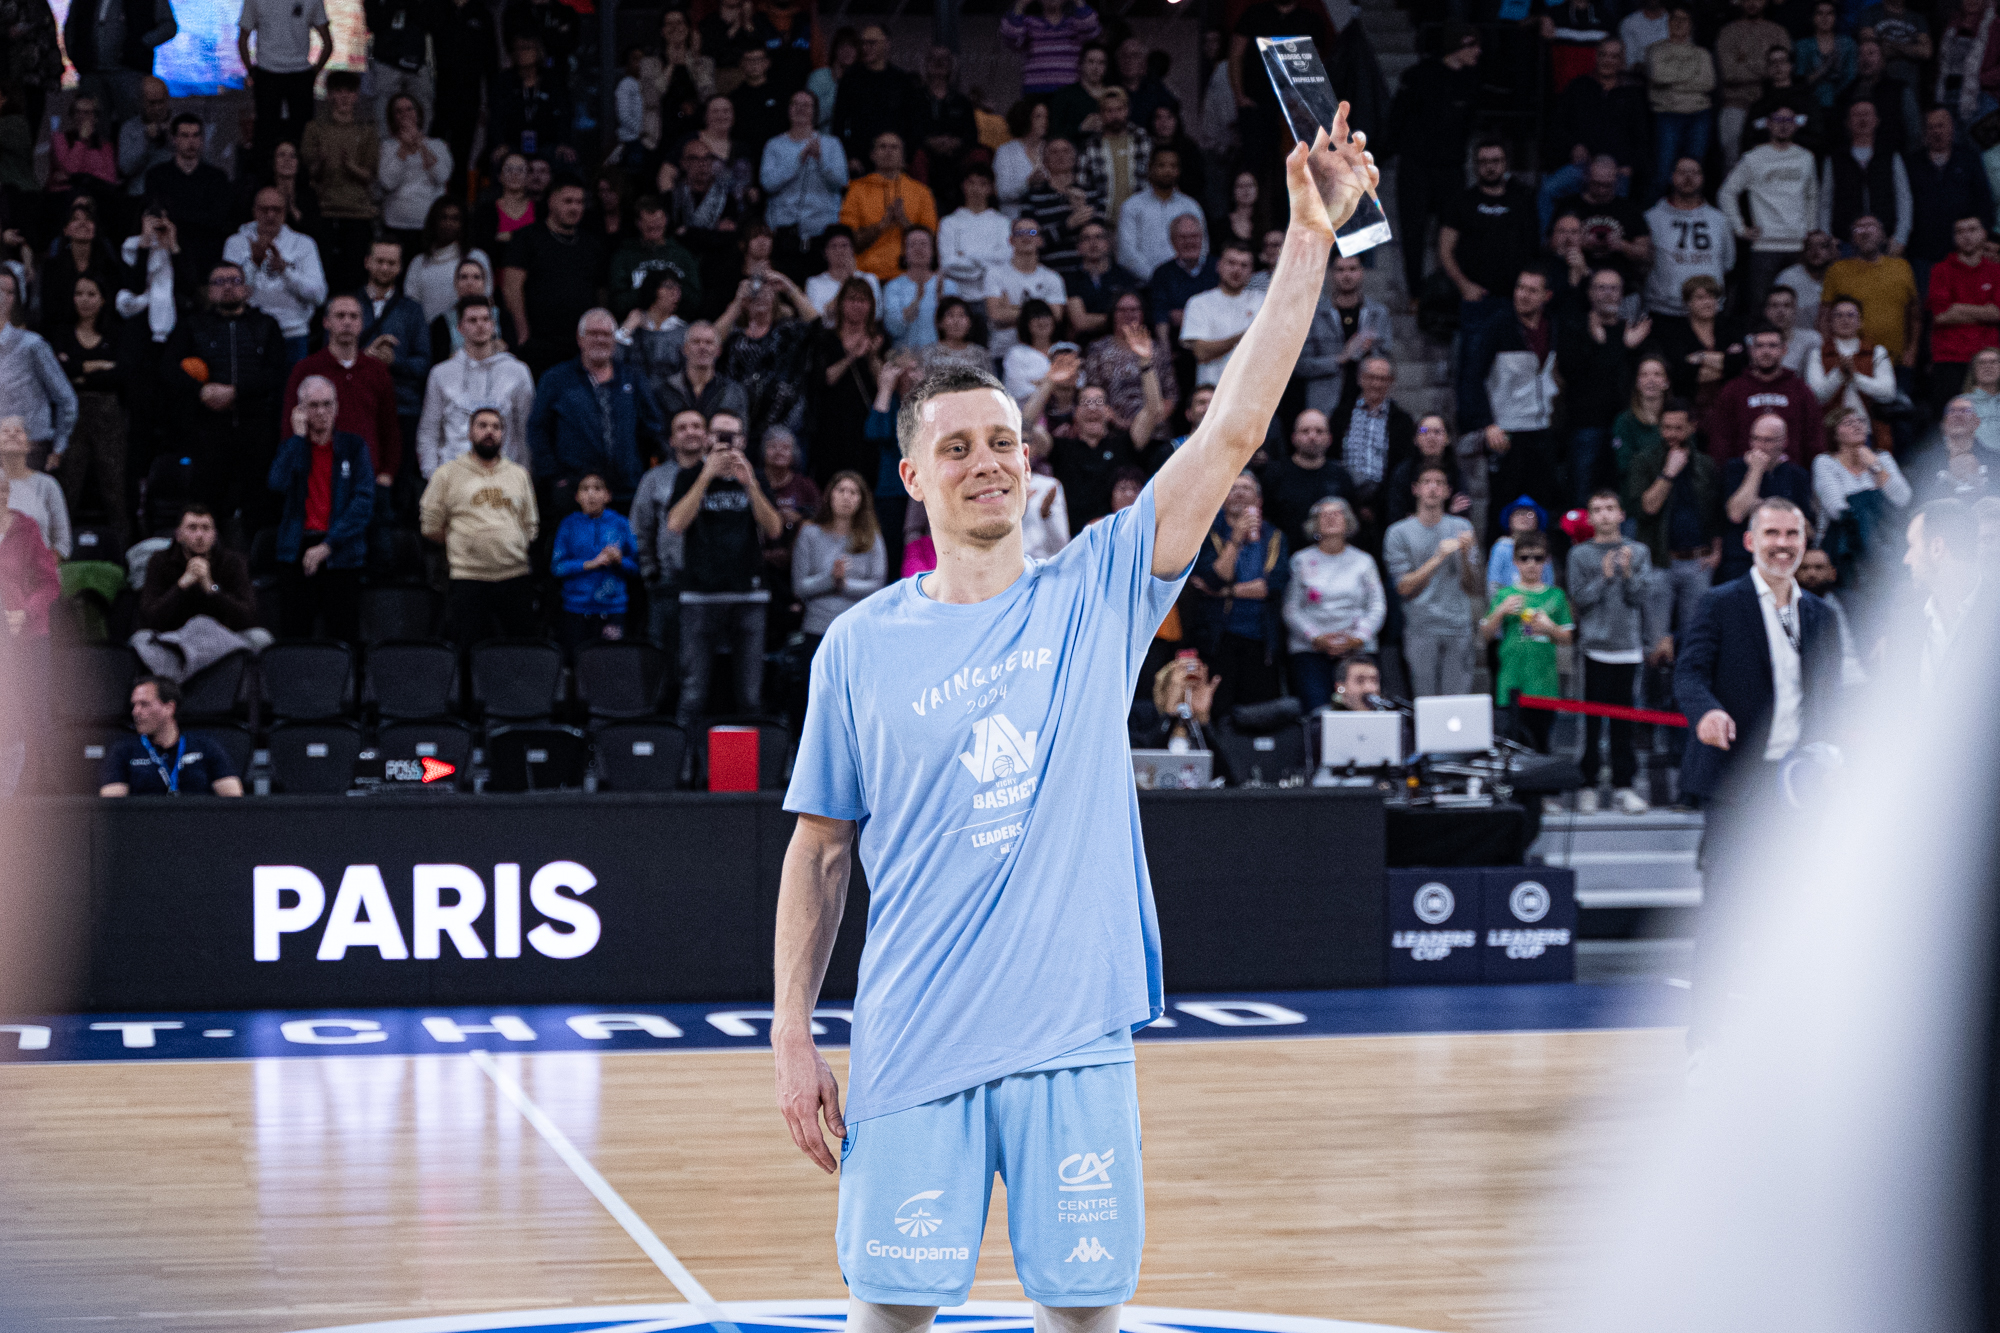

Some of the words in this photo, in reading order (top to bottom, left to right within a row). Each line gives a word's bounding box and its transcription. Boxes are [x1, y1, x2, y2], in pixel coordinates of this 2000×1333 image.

[1671, 220, 1711, 250] 76
[911, 647, 1053, 716] VAINQUEUR
[966, 684, 1008, 715] 2024
[973, 775, 1038, 809] BASKET
[995, 777, 1017, 789] VICHY
[971, 821, 1025, 848] LEADERS
[252, 860, 602, 961] PARIS
[1391, 929, 1477, 948] LEADERS
[1486, 928, 1571, 946] LEADERS
[1411, 945, 1452, 961] CUP
[1505, 943, 1547, 959] CUP
[1057, 1197, 1118, 1211] CENTRE
[1057, 1209, 1118, 1223] FRANCE
[866, 1239, 970, 1264] Groupama
